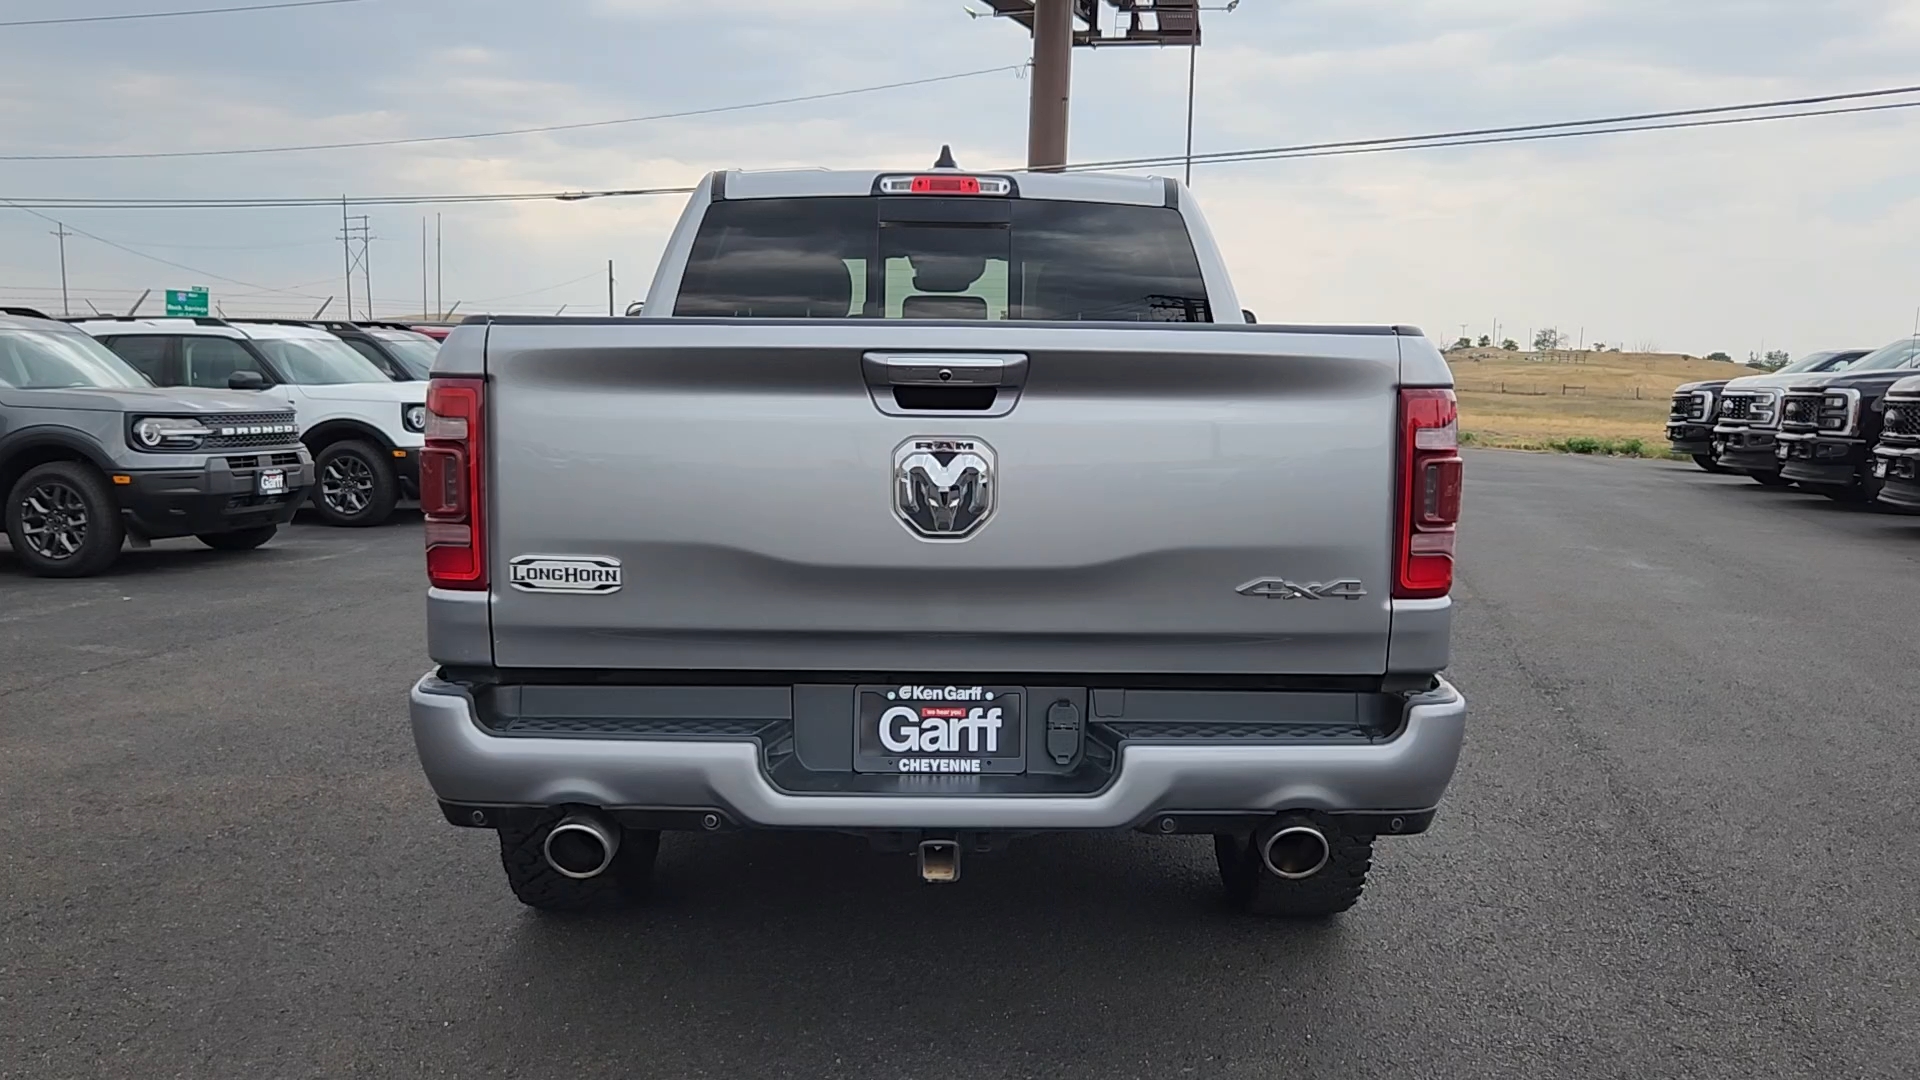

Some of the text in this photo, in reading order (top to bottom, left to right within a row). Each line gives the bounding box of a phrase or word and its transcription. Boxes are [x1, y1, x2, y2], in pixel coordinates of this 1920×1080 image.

[222, 426, 293, 435] BRONCO
[915, 441, 974, 450] RAM
[512, 566, 618, 583] LONGHORN
[913, 686, 982, 700] Ken Garff
[879, 706, 1002, 752] Garff
[899, 759, 981, 772] CHEYENNE
